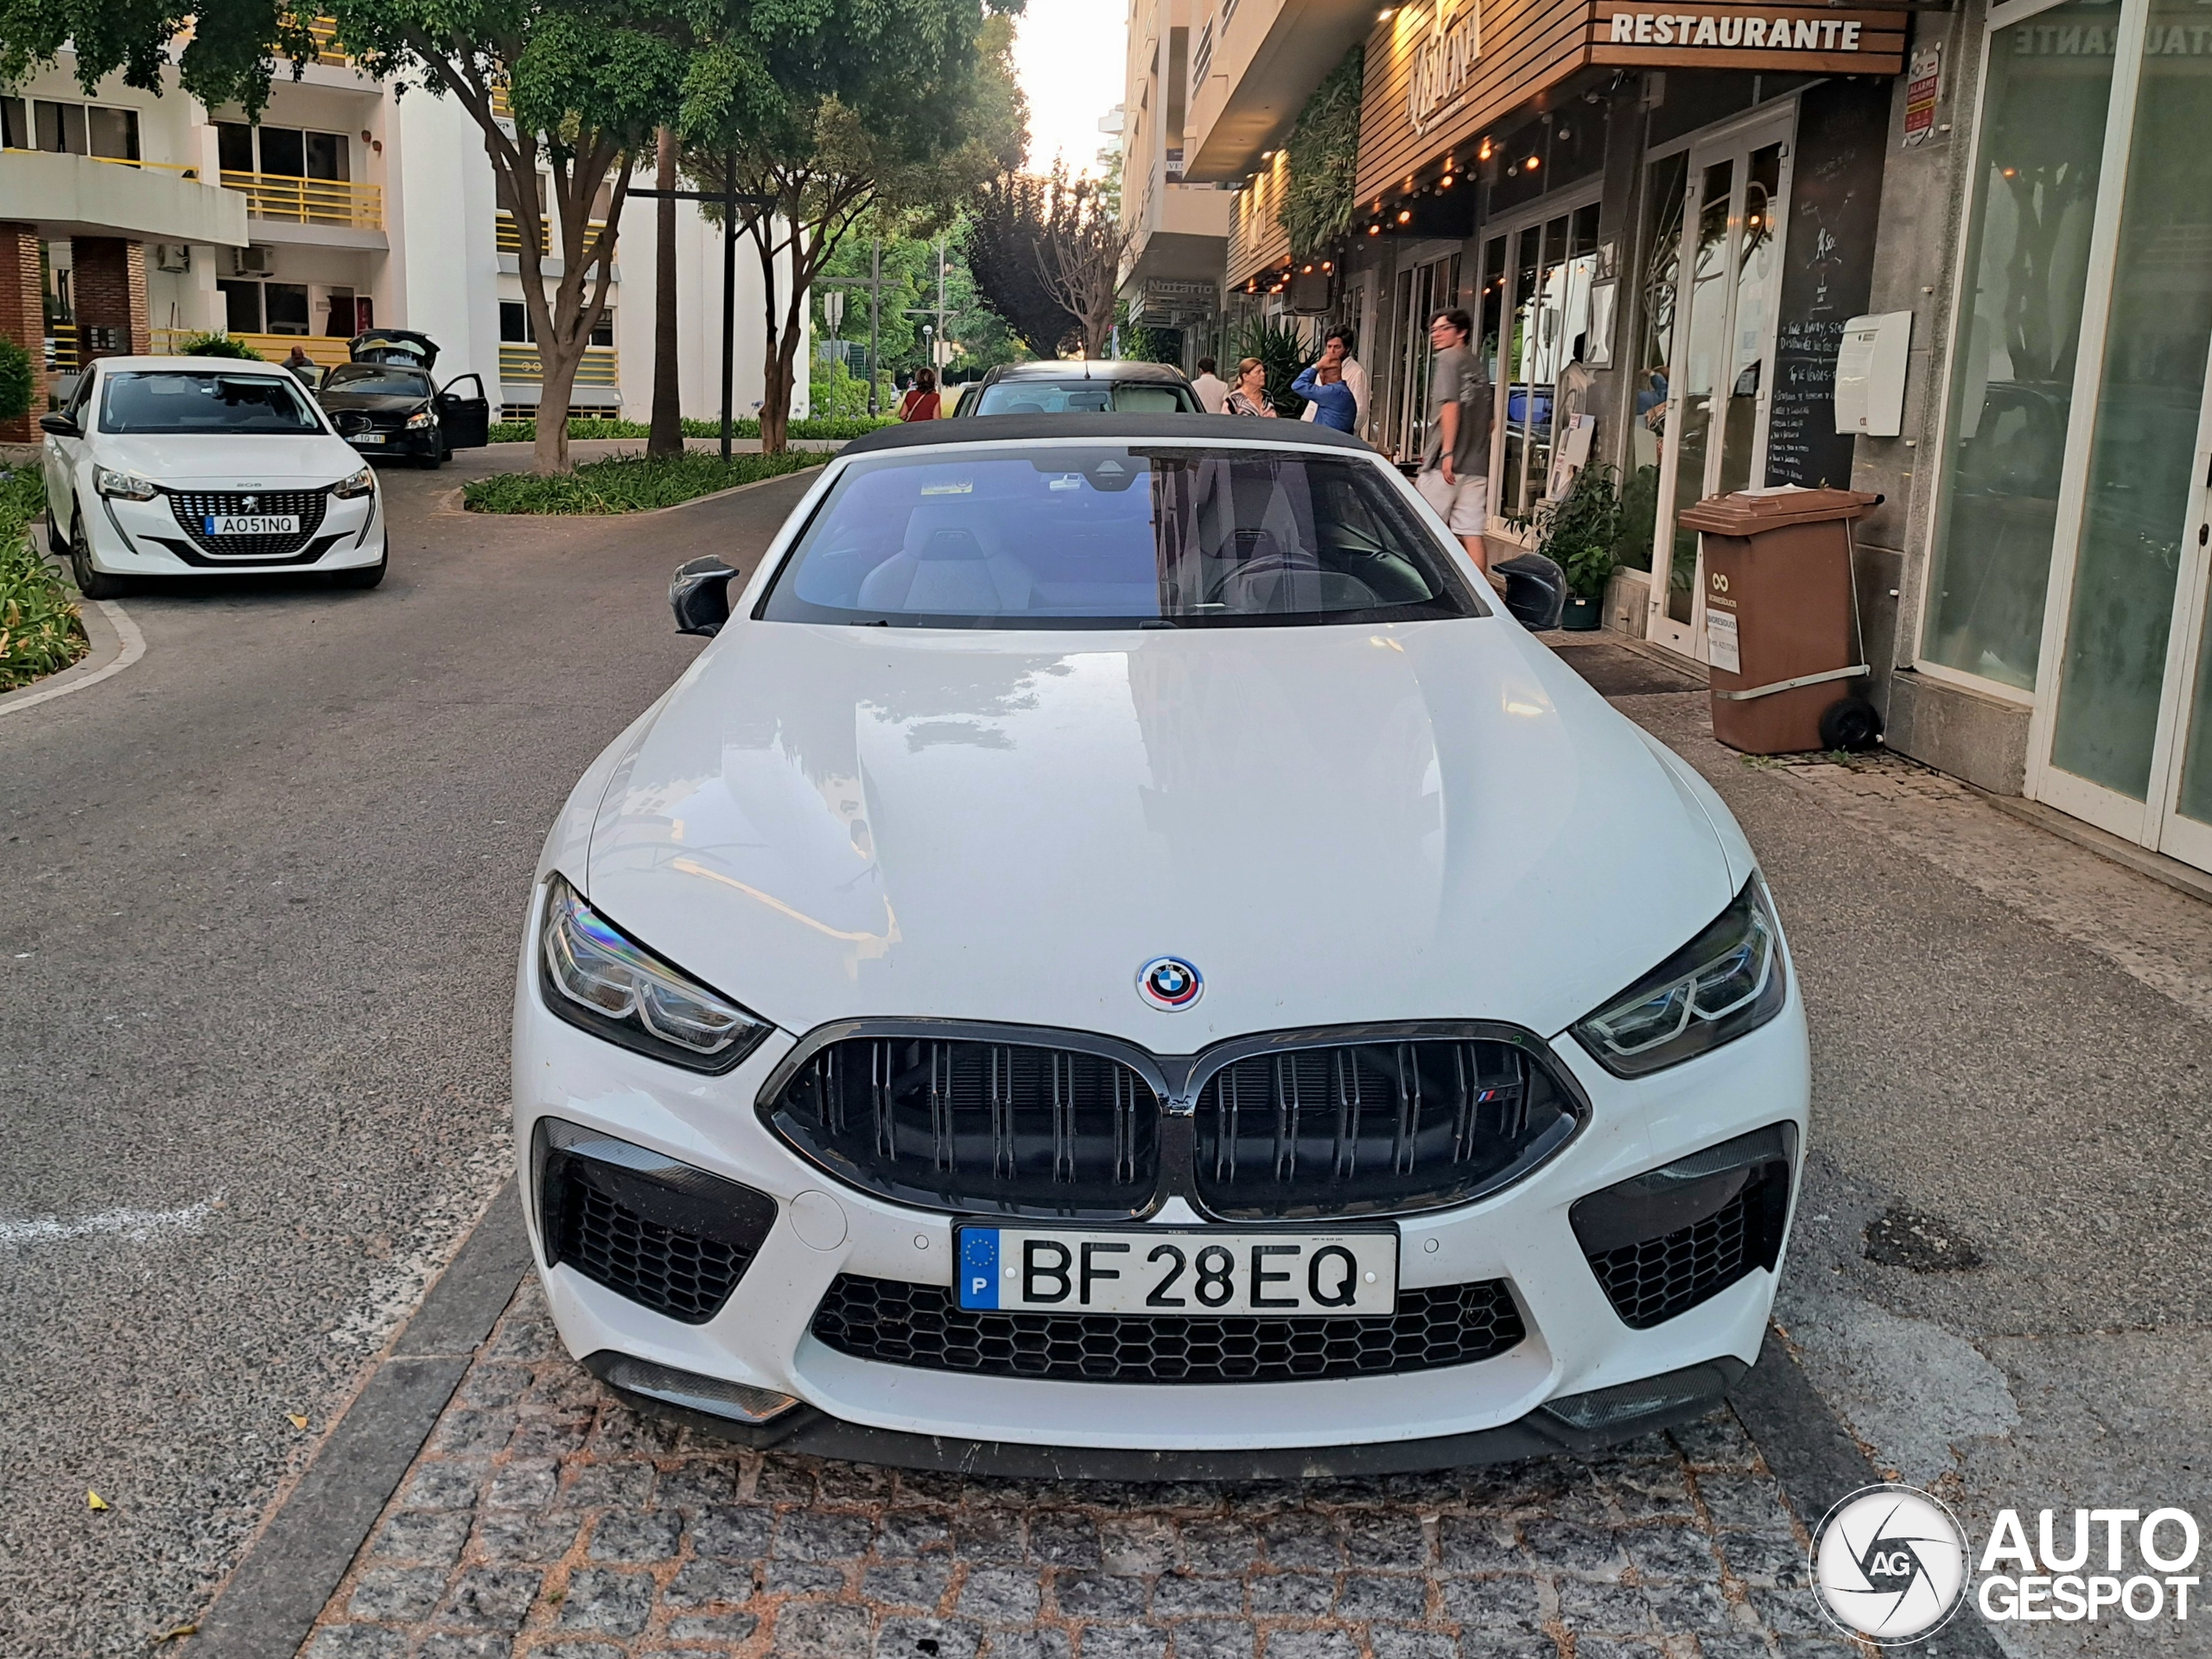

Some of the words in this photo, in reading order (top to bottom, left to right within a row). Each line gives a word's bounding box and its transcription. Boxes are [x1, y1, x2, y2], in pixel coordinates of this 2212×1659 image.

[1611, 13, 1862, 50] RESTAURANTE
[1910, 76, 1936, 95] ALARME
[1147, 279, 1213, 294] Notário
[1153, 964, 1187, 976] BMW
[972, 1277, 987, 1294] P
